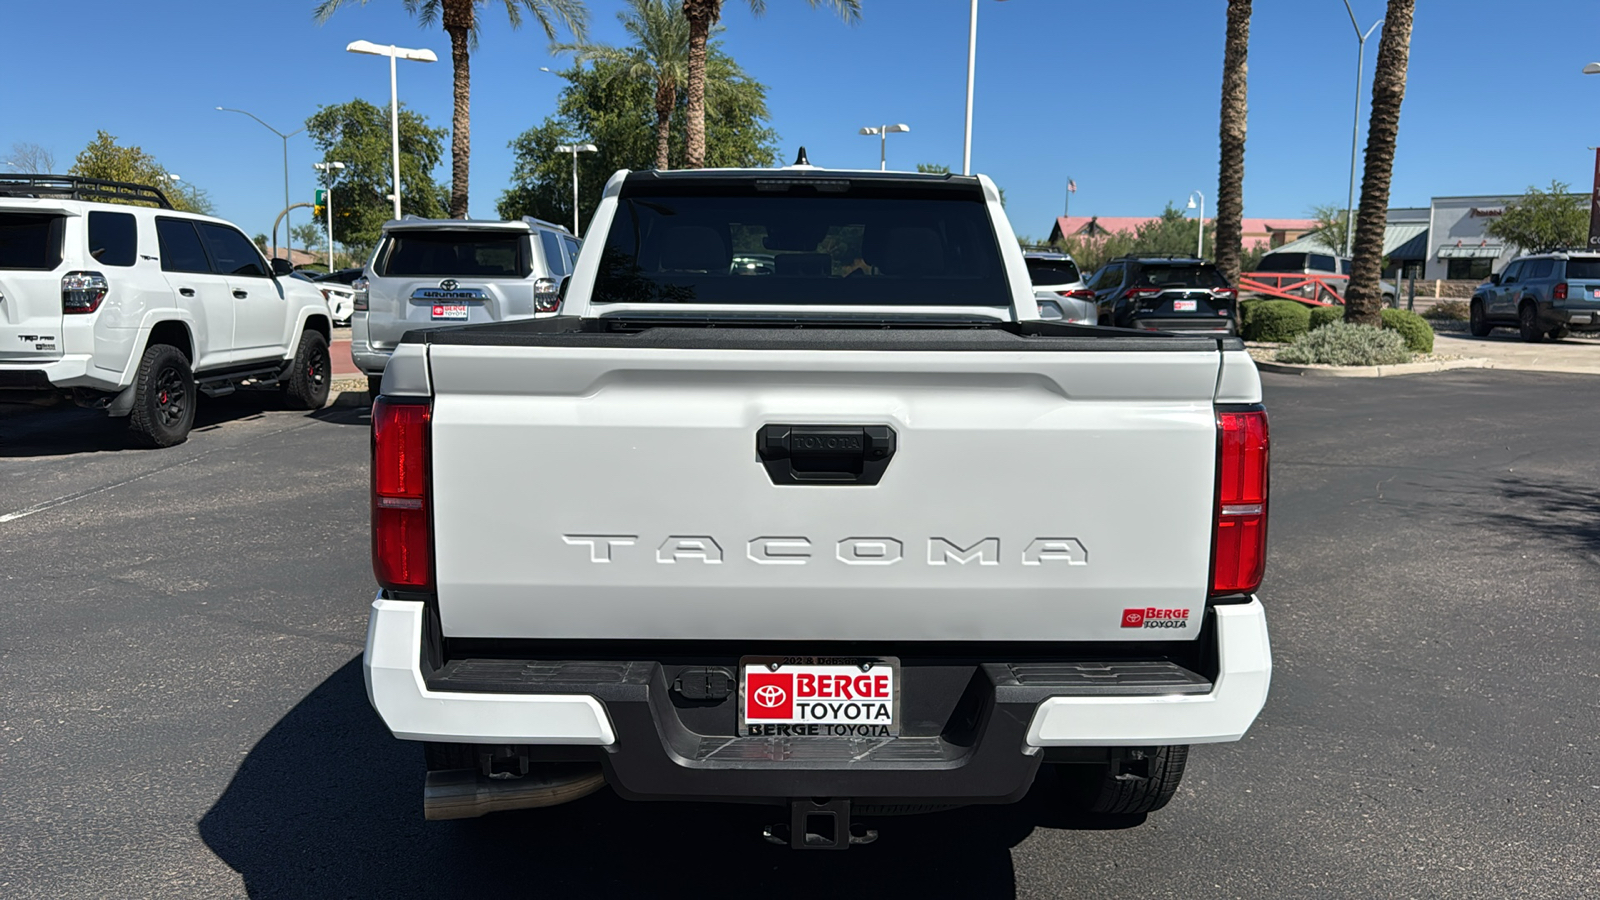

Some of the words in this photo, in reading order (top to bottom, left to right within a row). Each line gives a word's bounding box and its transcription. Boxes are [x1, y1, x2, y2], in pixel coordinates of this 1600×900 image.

[794, 437, 860, 449] TOYOTA
[562, 534, 1088, 566] TACOMA
[1145, 607, 1190, 619] BERGE
[1144, 620, 1187, 628] TOYOTA
[783, 657, 802, 665] 202
[806, 657, 815, 665] &
[817, 657, 858, 665] Dobson
[796, 673, 889, 700] BERGE
[796, 703, 891, 720] TOYOTA
[748, 724, 820, 737] BERGE
[823, 724, 891, 737] TOYOTA
